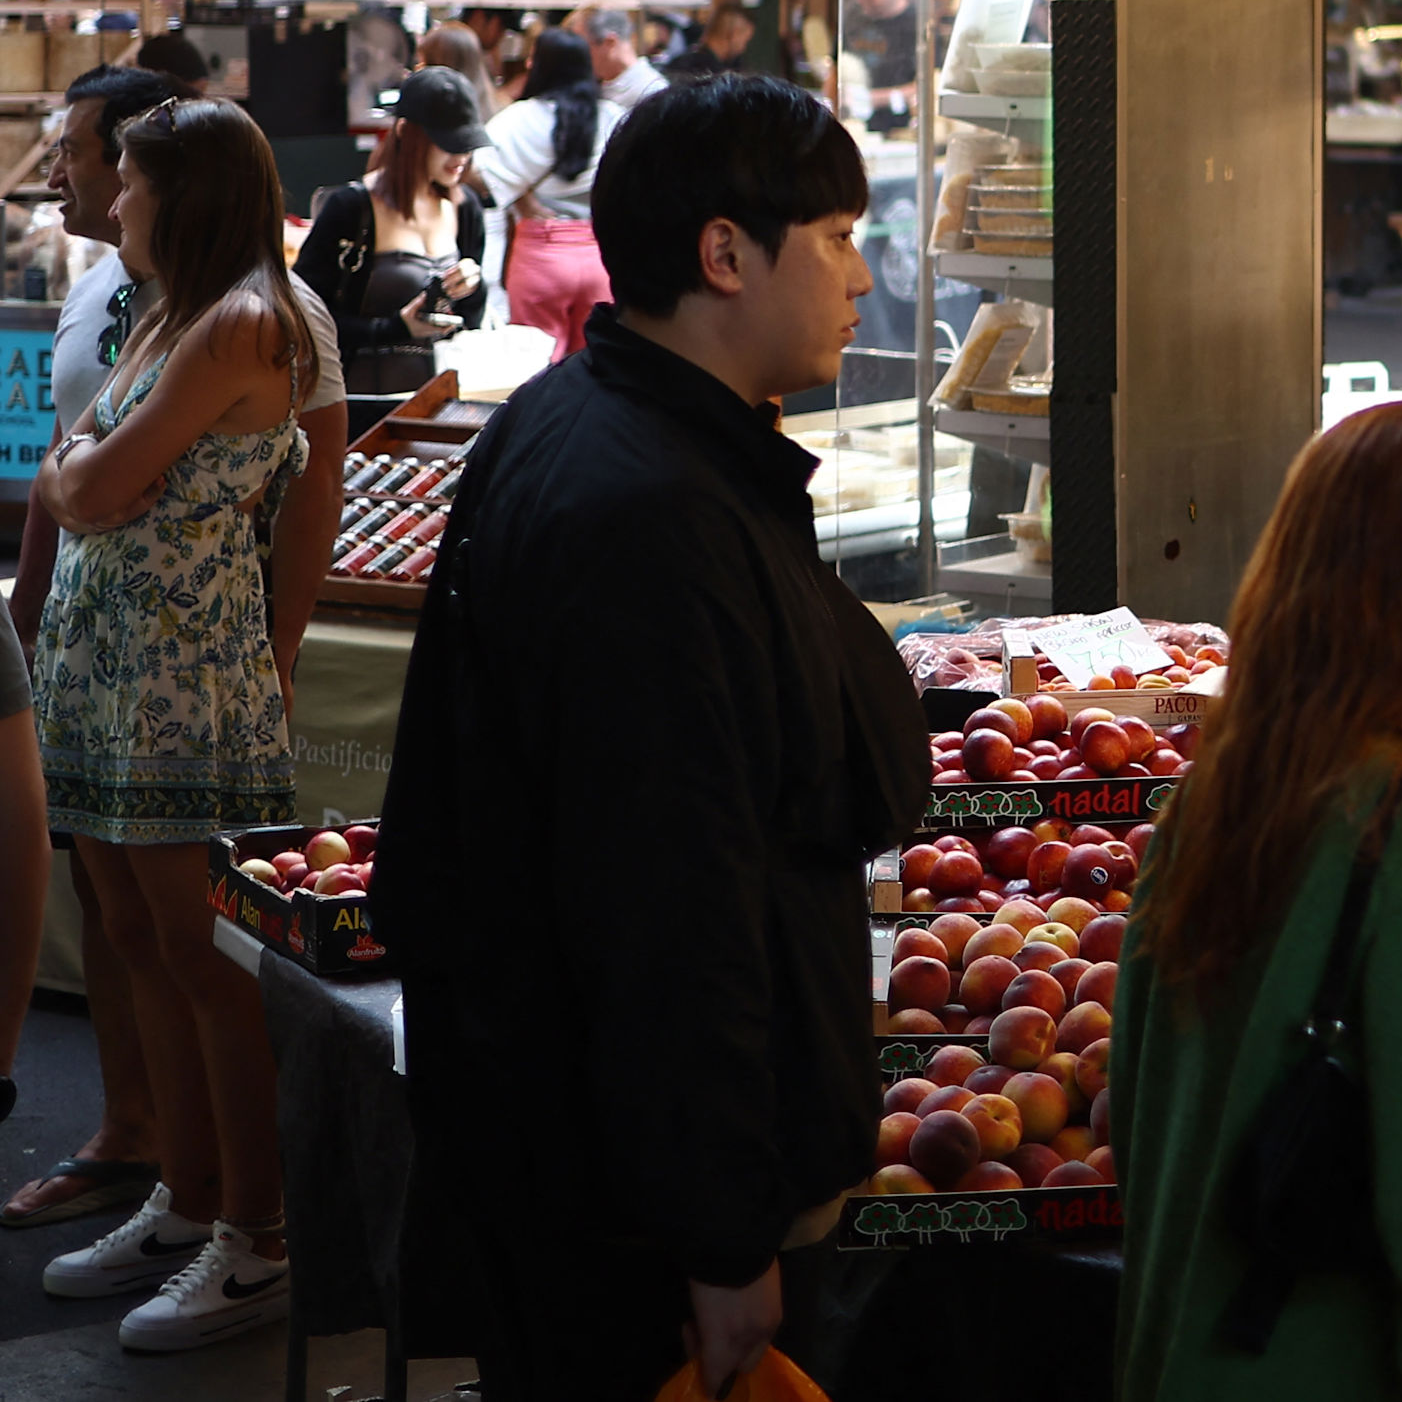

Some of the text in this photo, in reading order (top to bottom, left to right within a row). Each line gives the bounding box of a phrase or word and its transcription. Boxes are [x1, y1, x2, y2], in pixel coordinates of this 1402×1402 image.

[1154, 697, 1197, 714] PACO
[293, 734, 393, 777] Pastificio
[1048, 782, 1142, 818] nadal
[1034, 1189, 1127, 1231] nada
